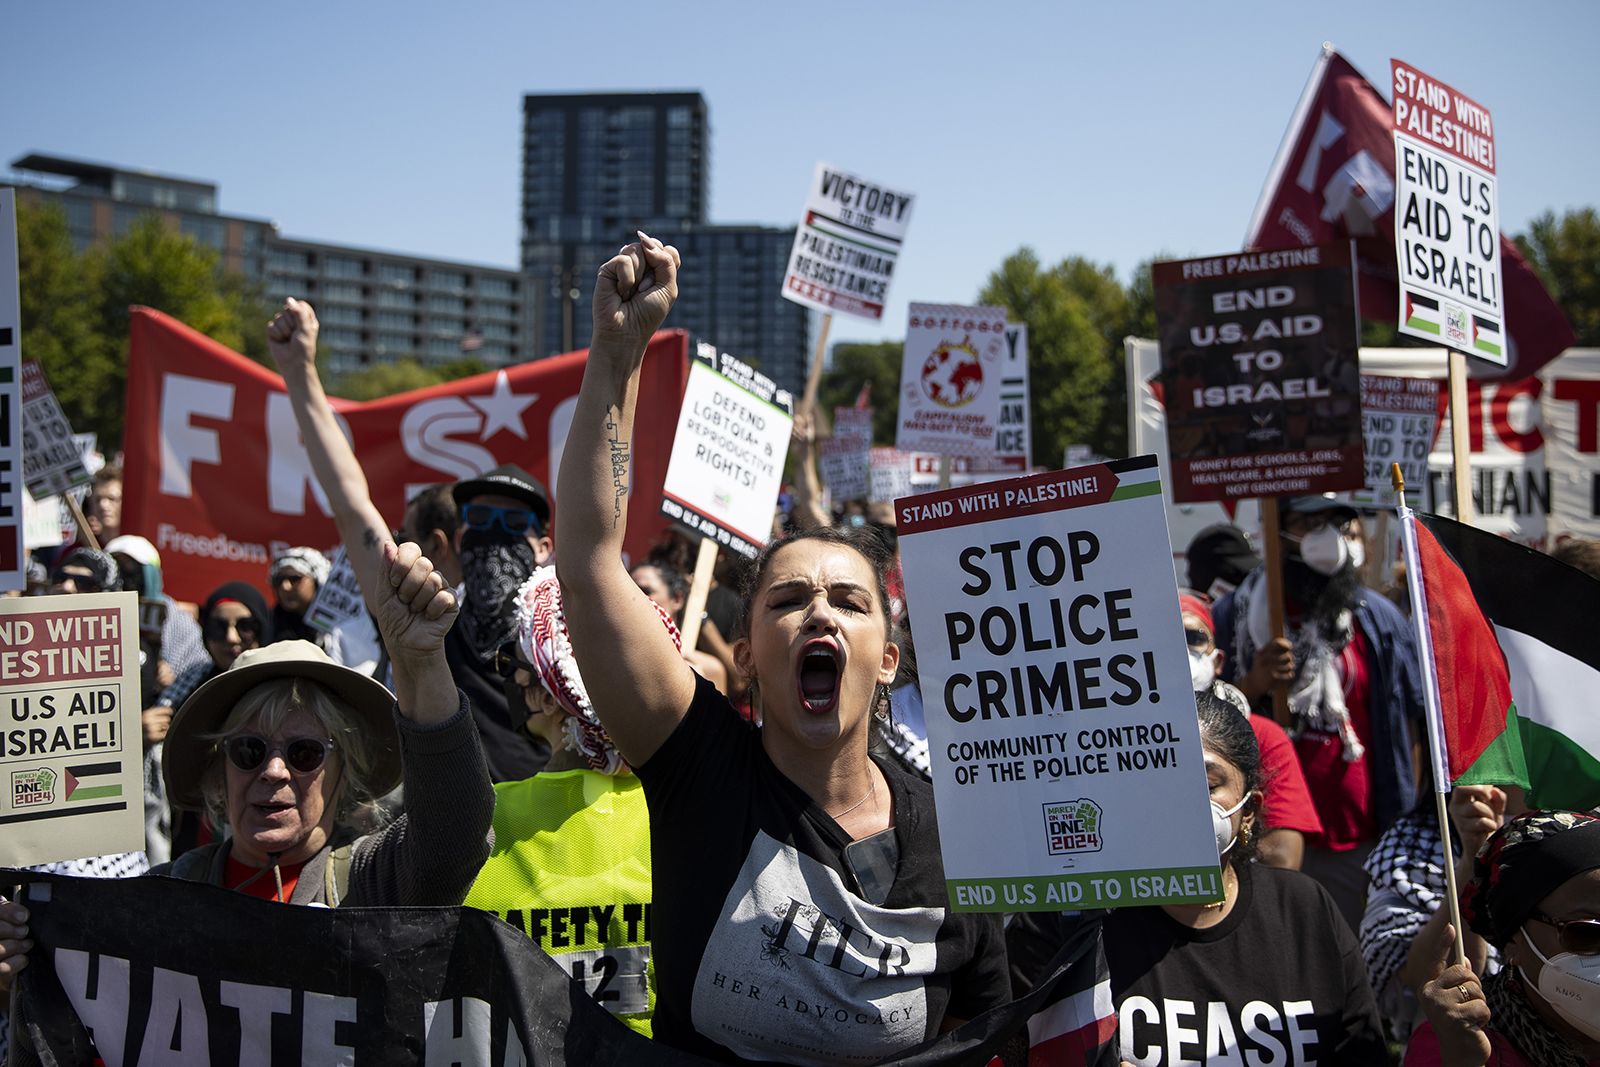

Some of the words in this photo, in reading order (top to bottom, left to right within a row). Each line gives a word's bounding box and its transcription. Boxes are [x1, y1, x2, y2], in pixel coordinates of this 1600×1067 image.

[1395, 67, 1450, 114] STAND
[1454, 96, 1492, 137] WITH
[1395, 98, 1494, 169] PALESTINE!
[821, 169, 912, 222] VICTORY
[1404, 146, 1449, 195] END
[1459, 171, 1491, 216] U.S
[1402, 192, 1452, 242] AID
[1462, 213, 1494, 262] TO
[801, 232, 894, 277] PALESTINIAN
[1182, 255, 1223, 279] FREE
[1226, 248, 1320, 274] PALESTINE
[1404, 239, 1498, 308] ISRAEL!
[795, 254, 888, 298] RESISTANCE
[1212, 286, 1296, 314] END
[1005, 330, 1018, 360] Y
[1190, 322, 1248, 347] U.S.
[1252, 314, 1323, 341] AID
[1232, 350, 1283, 373] TO
[713, 391, 766, 431] DEFEND
[1193, 377, 1331, 408] ISRAEL
[687, 418, 775, 478] REPRODUCTIVE
[695, 443, 758, 490] RIGHTS!
[1189, 460, 1229, 472] MONEY
[1231, 457, 1252, 469] FOR
[1403, 439, 1427, 460] TO
[902, 502, 954, 525] STAND
[958, 493, 1000, 515] WITH
[1005, 476, 1099, 506] PALESTINE!
[1225, 484, 1249, 496] NOT
[157, 523, 268, 564] Freedom
[959, 530, 1101, 596] STOP
[46, 614, 119, 643] WITH
[945, 588, 1139, 661] POLICE
[1, 644, 121, 680] ESTINE!
[11, 695, 56, 722] U.S
[68, 690, 116, 717] AID
[943, 651, 1161, 724] CRIMES!
[0, 721, 116, 758] ISRAEL!
[947, 732, 1069, 763] COMMUNITY
[1077, 722, 1180, 751] CONTROL
[955, 765, 980, 786] OF
[987, 762, 1027, 783] THE
[1034, 753, 1110, 780] POLICE
[1117, 747, 1178, 772] NOW!
[15, 782, 42, 794] DNC
[15, 791, 52, 805] 2024
[1047, 805, 1076, 815] MARCH
[1048, 814, 1059, 822] ON
[1049, 819, 1085, 836] DNC
[1051, 833, 1099, 851] 2024
[955, 884, 996, 906] END
[1003, 884, 1038, 904] U.S
[1045, 881, 1083, 902] AID
[1090, 878, 1122, 900] TO
[1130, 873, 1218, 900] ISRAEL!
[488, 904, 616, 948] AFETY
[54, 947, 358, 1067] HATE
[712, 971, 761, 1000] HER
[776, 996, 914, 1026] ADVOCACY
[1119, 995, 1319, 1067] CEASE
